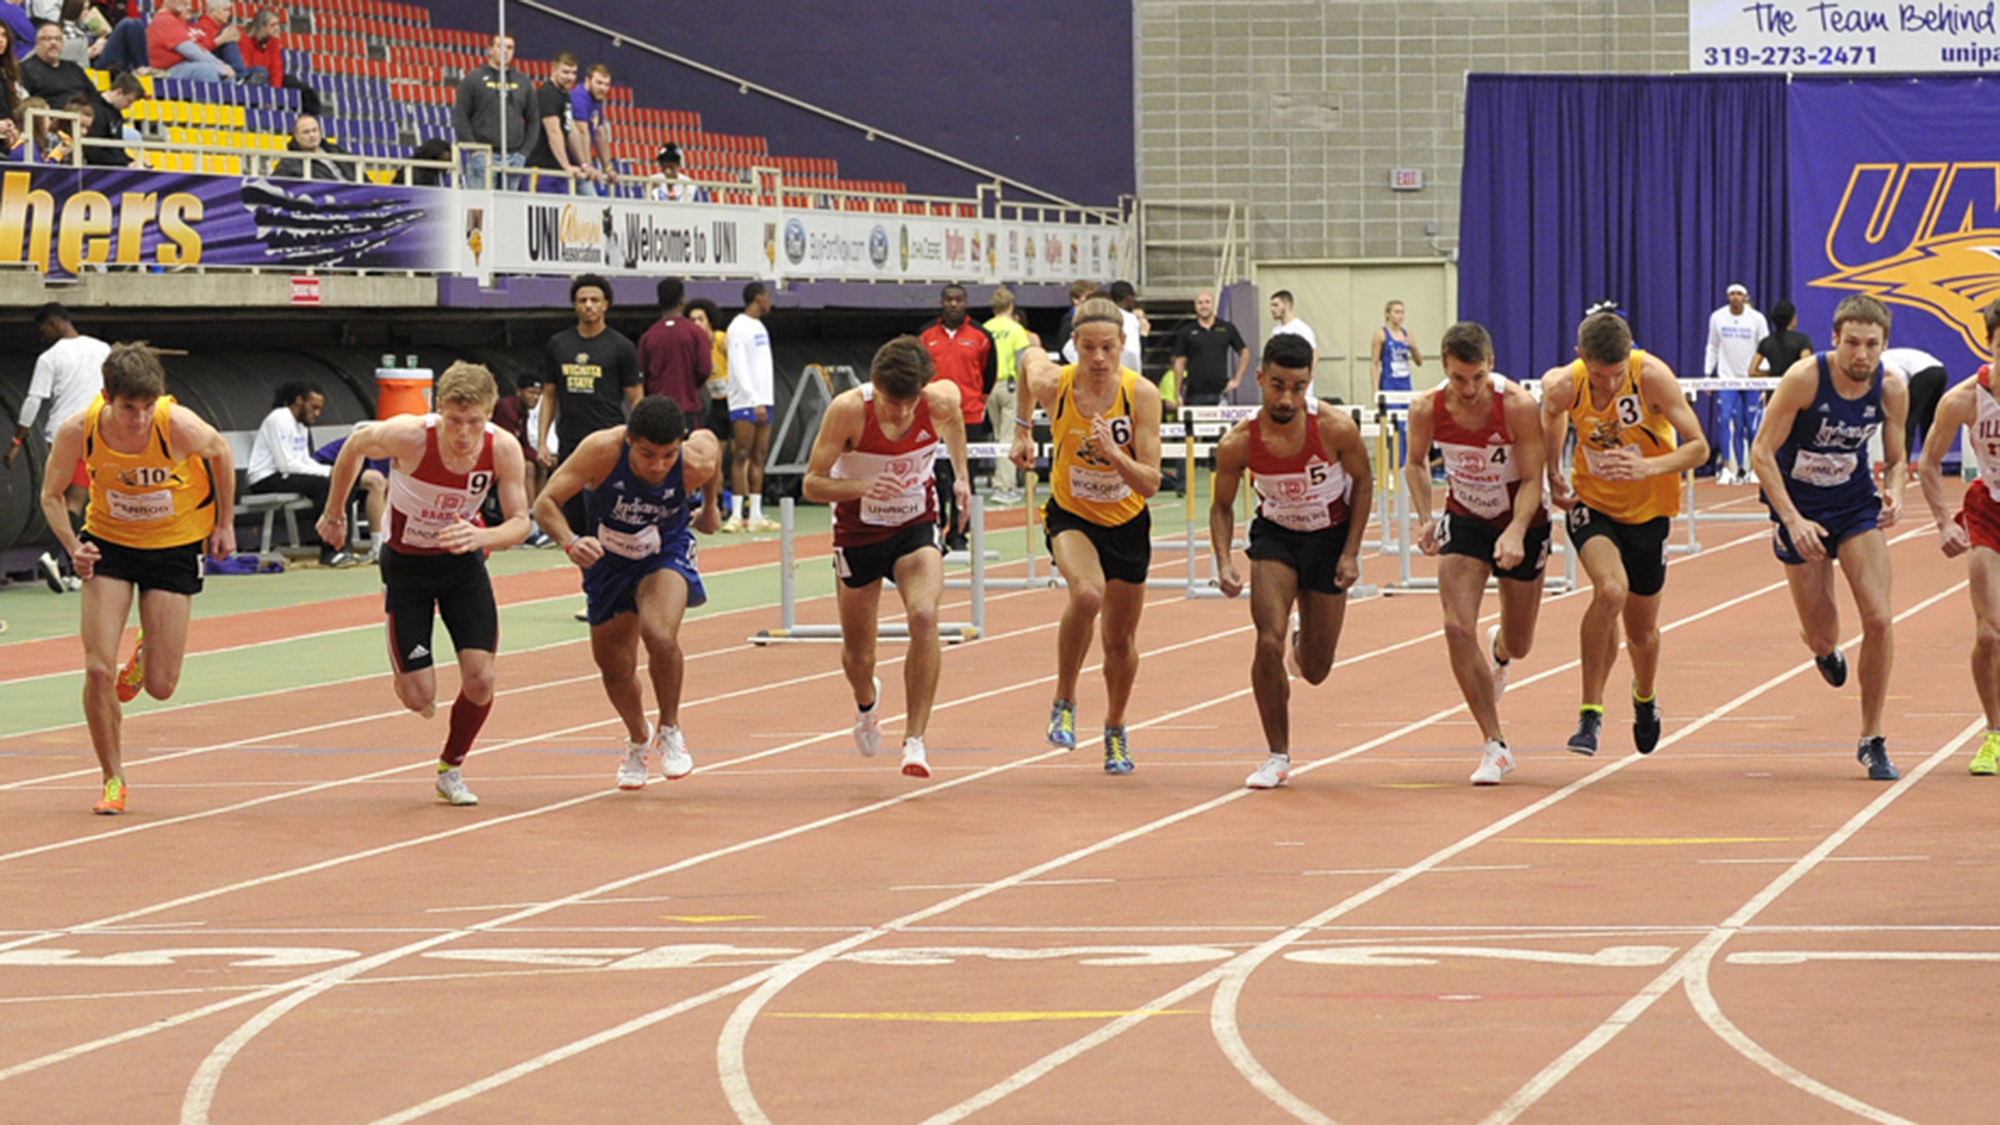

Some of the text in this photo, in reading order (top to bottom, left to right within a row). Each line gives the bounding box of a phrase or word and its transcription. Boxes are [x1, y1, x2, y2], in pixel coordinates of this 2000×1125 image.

[1742, 1, 1994, 36] The Team Behind
[1704, 46, 1877, 66] 319-273-2471
[1396, 171, 1417, 186] EXIT
[527, 205, 559, 262] UNI
[624, 212, 737, 264] Welcome to UNI
[561, 363, 603, 378] WICHITA
[567, 376, 595, 389] STATE
[1619, 397, 1639, 425] 3
[1111, 419, 1130, 445] 6
[1490, 447, 1507, 465] 4
[139, 467, 166, 485] 10
[470, 473, 488, 495] 9
[1309, 465, 1327, 486] 5
[867, 503, 919, 515] UHRICH
